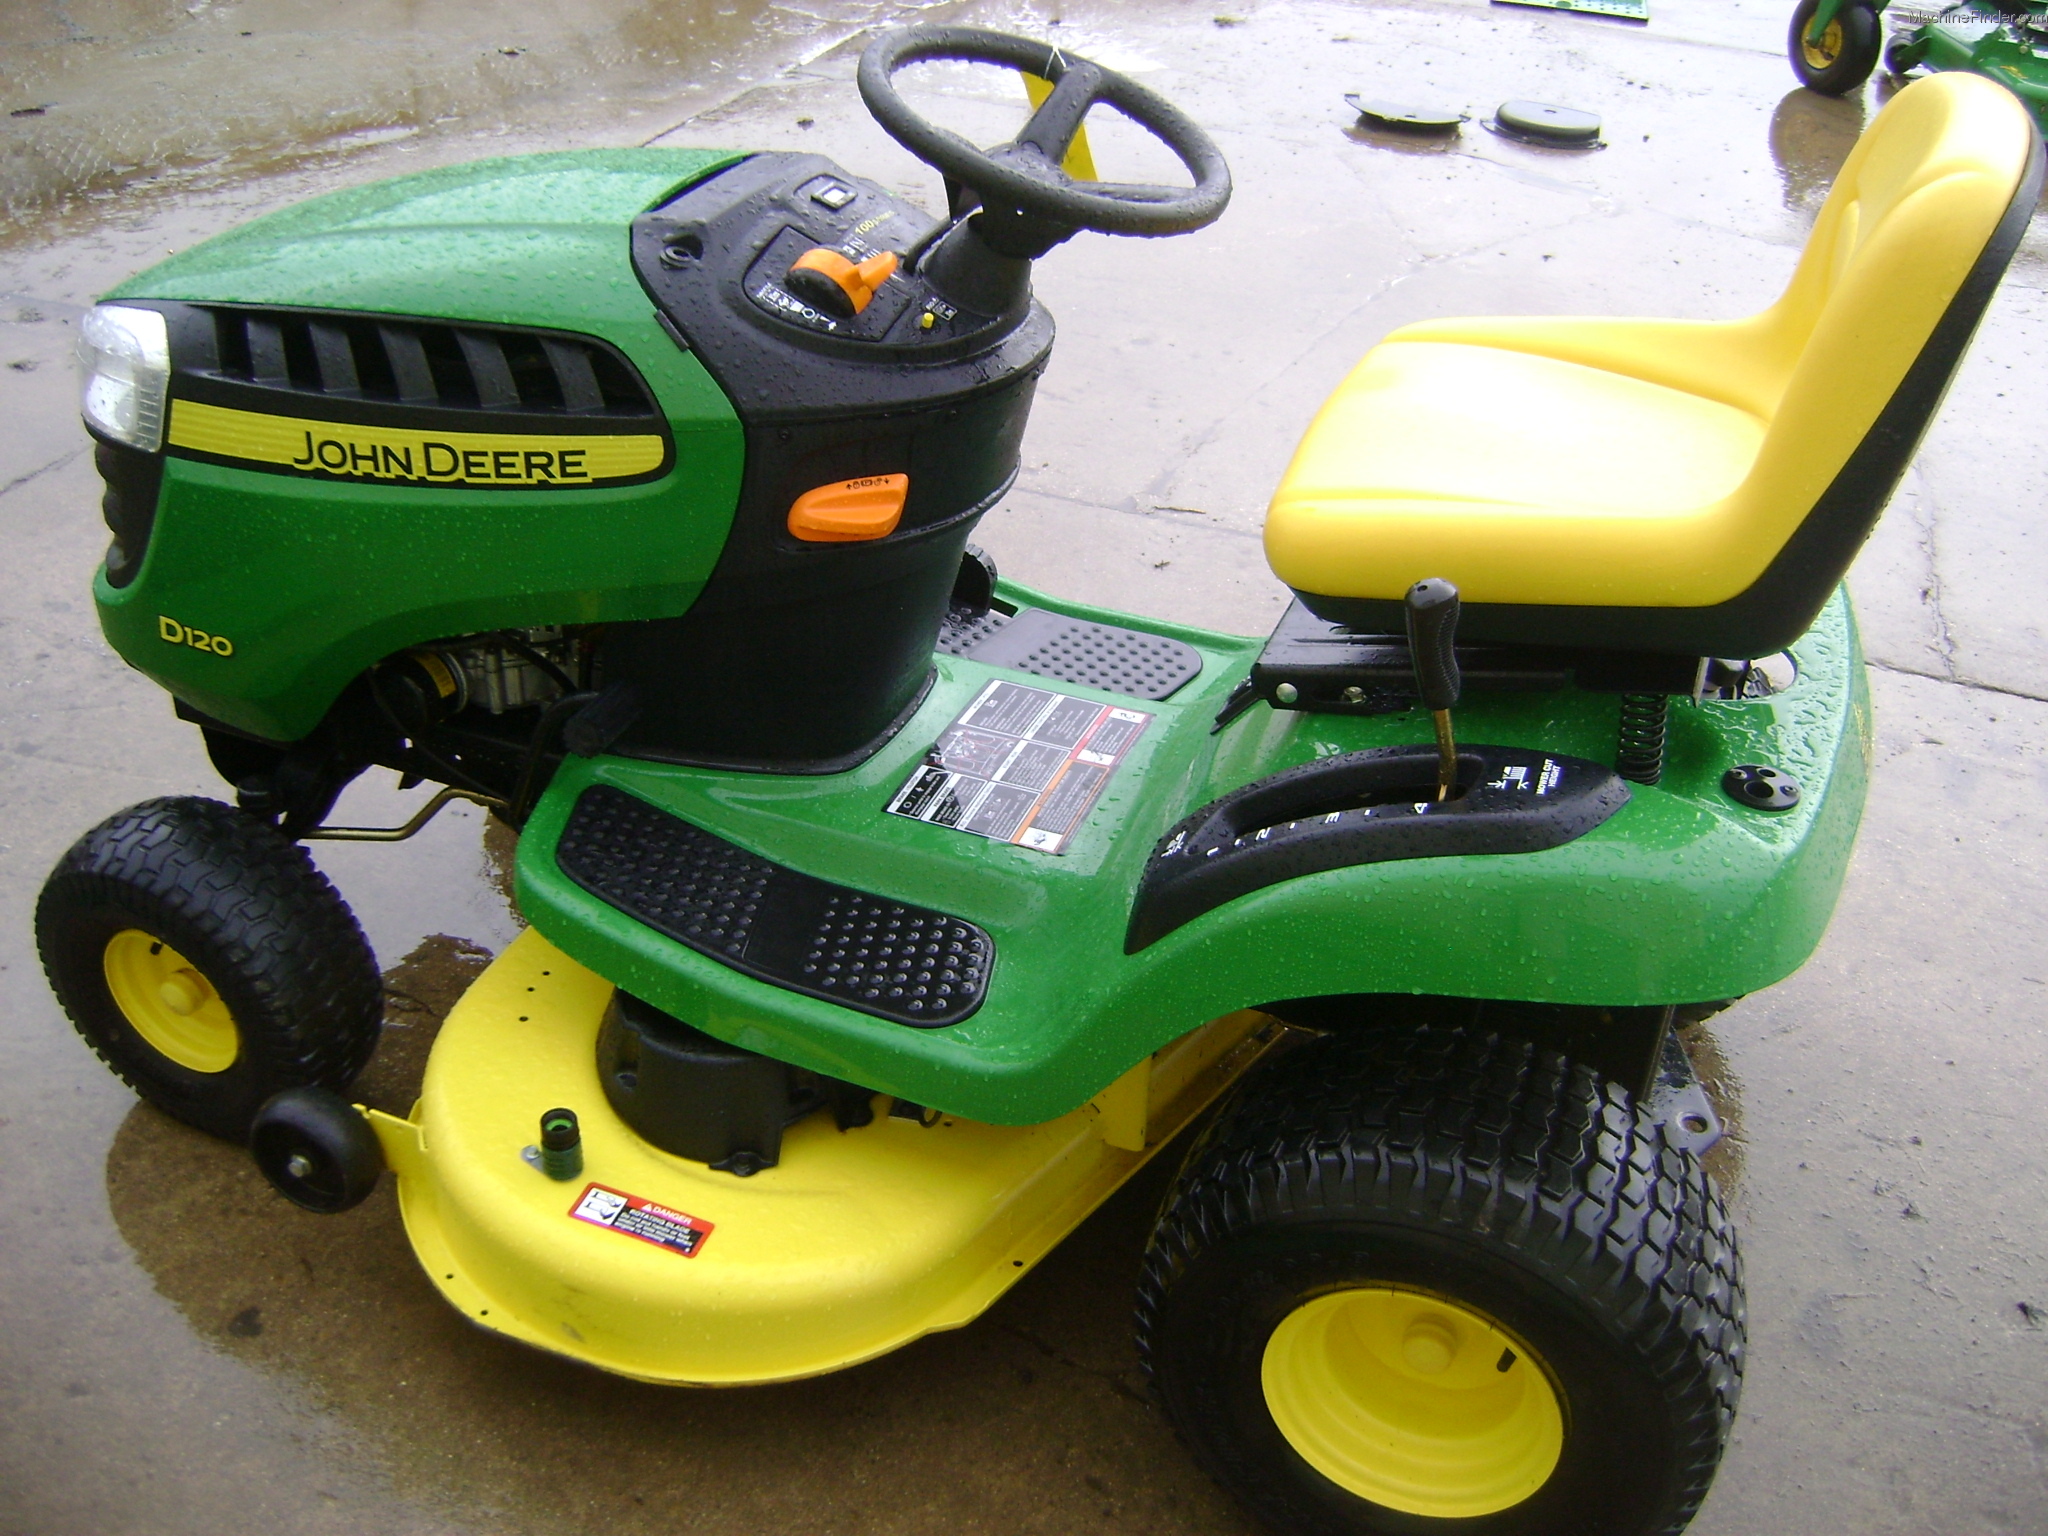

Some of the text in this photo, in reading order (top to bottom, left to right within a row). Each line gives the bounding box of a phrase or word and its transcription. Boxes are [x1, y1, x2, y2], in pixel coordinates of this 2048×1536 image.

[293, 430, 590, 480] JOHN DEERE
[158, 614, 234, 657] D120
[653, 1206, 692, 1225] DANGER
